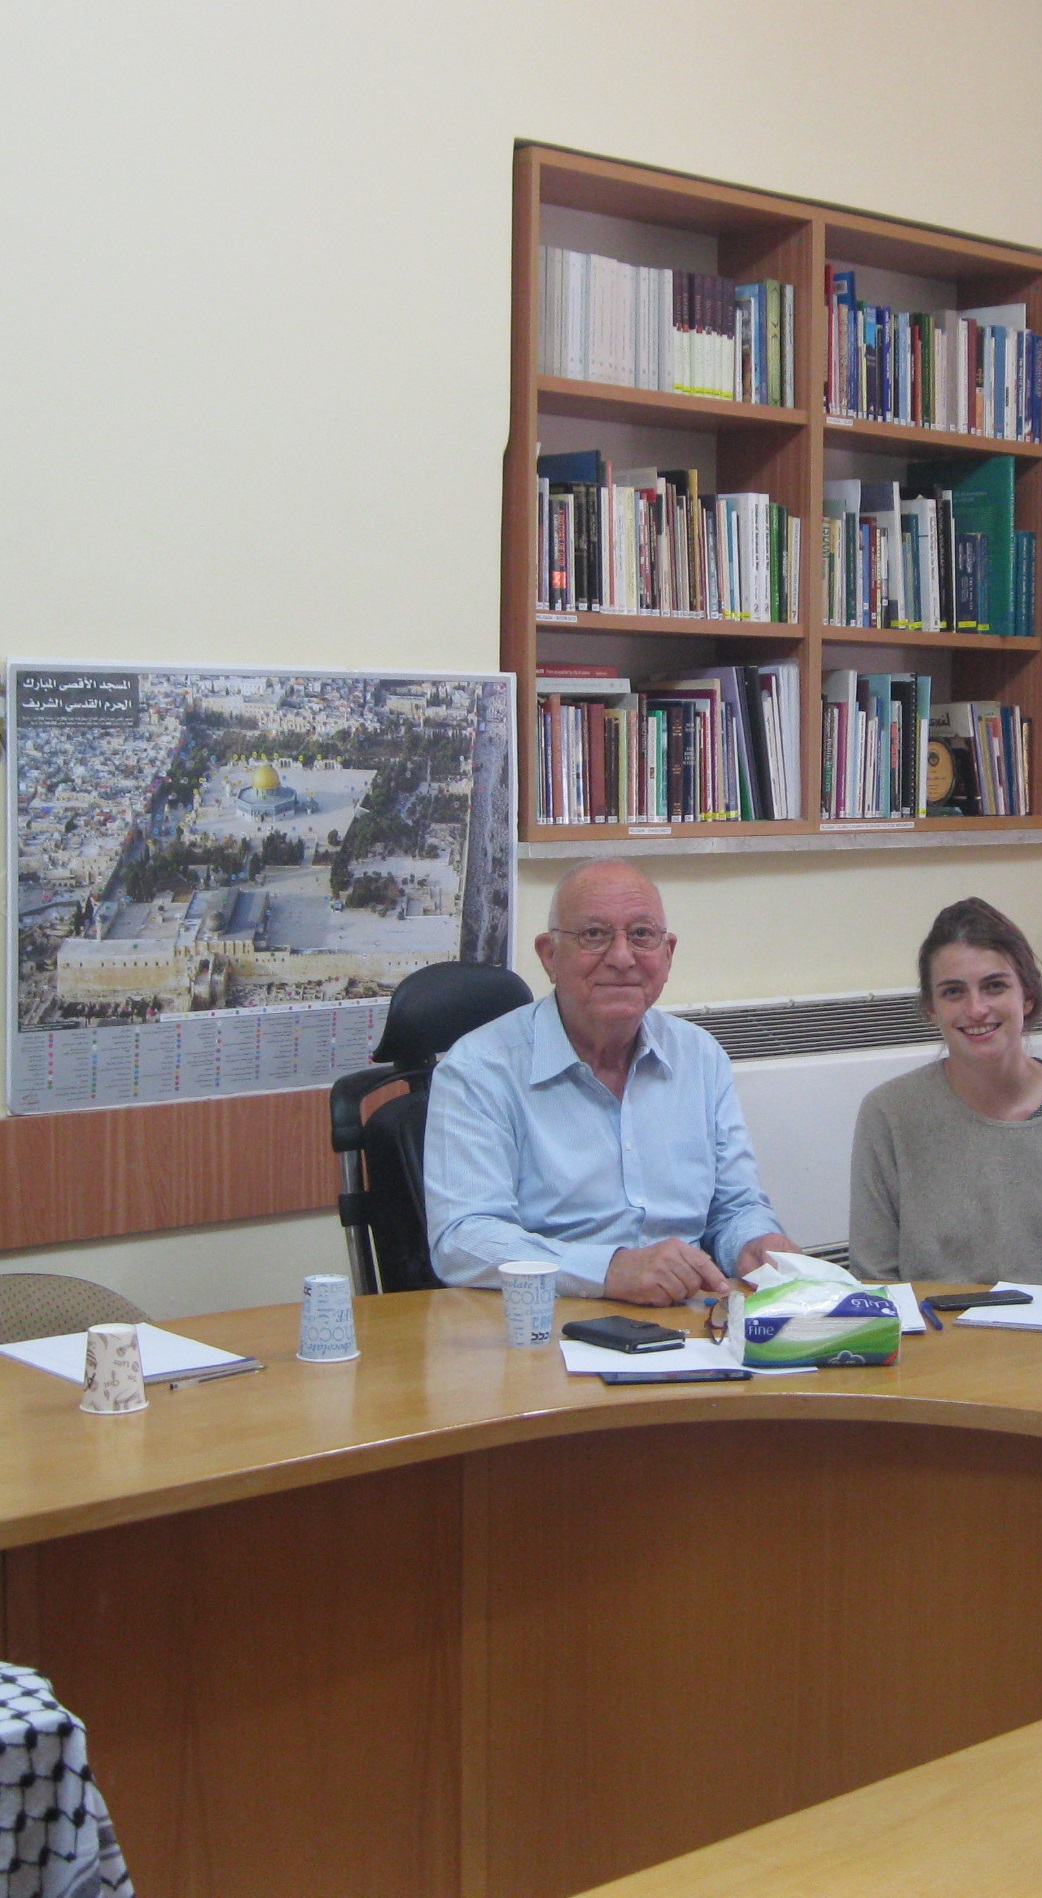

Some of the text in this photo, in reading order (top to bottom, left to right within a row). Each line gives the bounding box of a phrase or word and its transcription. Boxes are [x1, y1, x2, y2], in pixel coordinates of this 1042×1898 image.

[22, 677, 131, 692] المسجد الأقصى المبارك
[22, 698, 132, 713] الحرم القدسي الشريف
[748, 1320, 775, 1336] Fine
